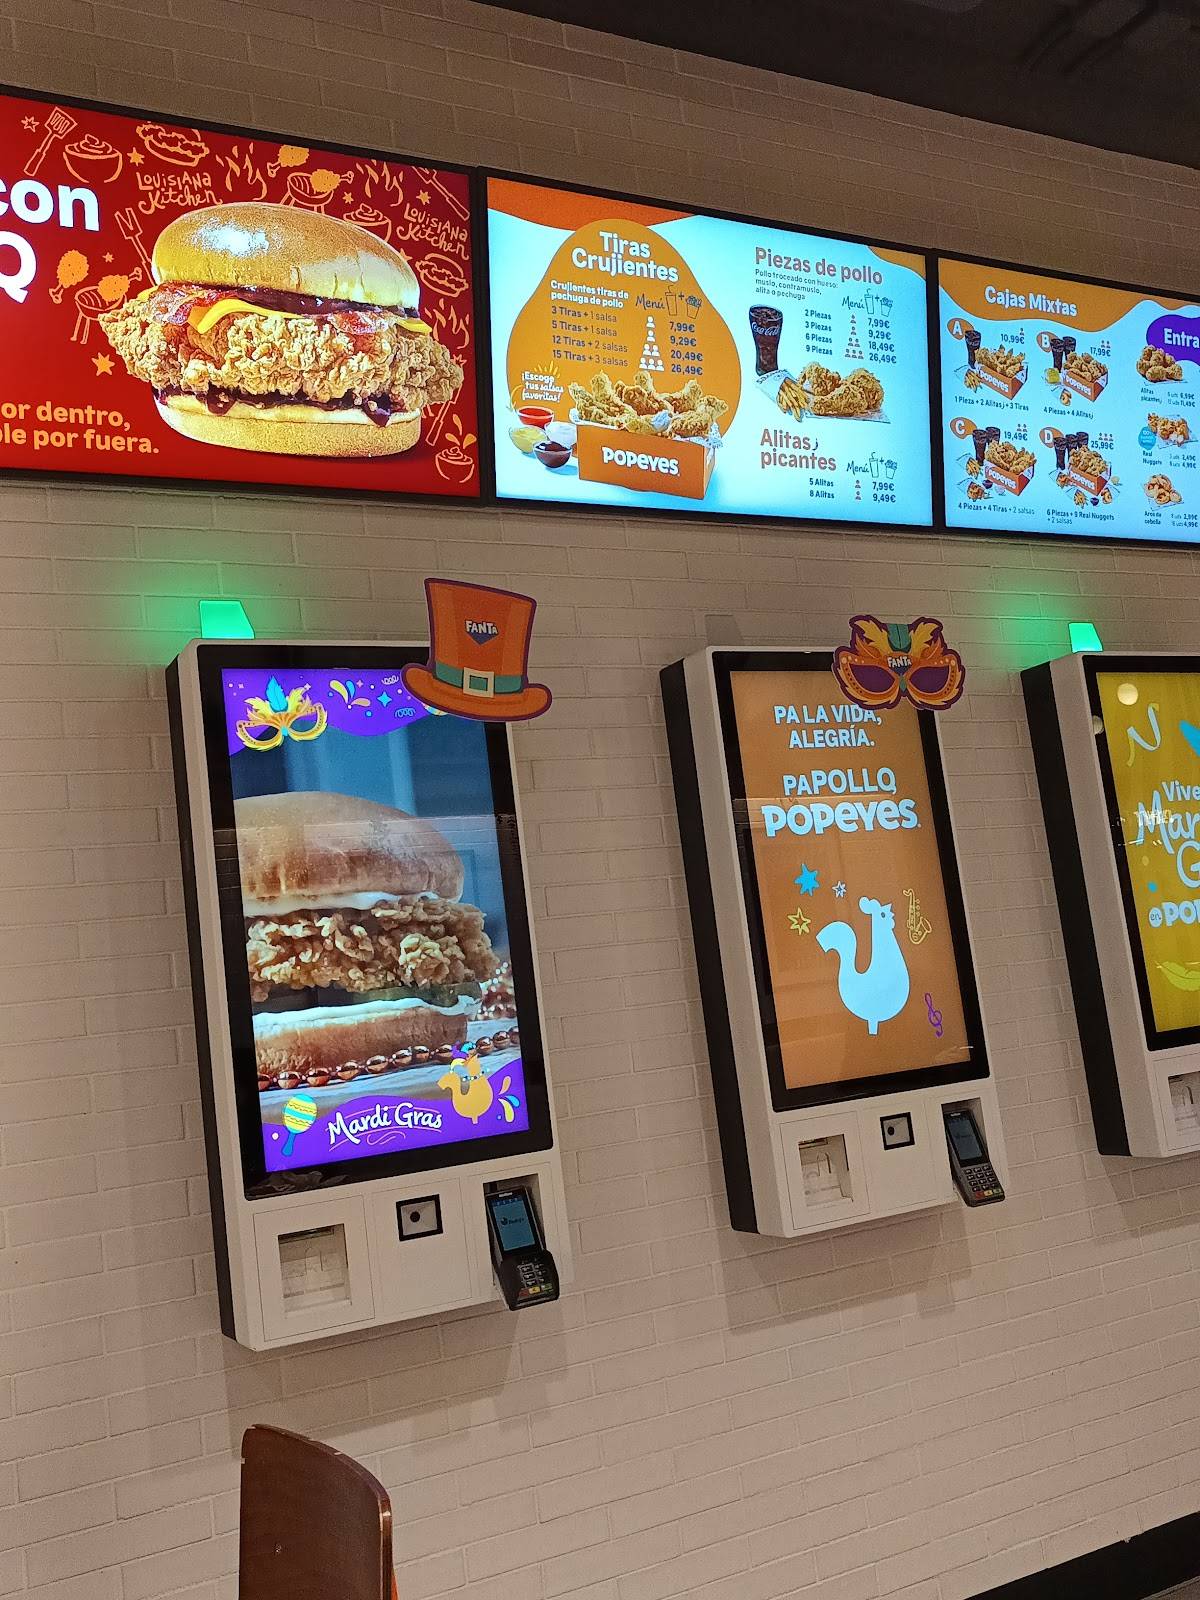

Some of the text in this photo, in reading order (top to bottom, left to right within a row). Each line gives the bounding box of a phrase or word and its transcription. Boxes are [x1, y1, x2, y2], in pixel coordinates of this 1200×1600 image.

[0, 177, 100, 232] on
[138, 185, 223, 214] Kitchen
[396, 222, 469, 260] Kitchen
[599, 231, 651, 258] Tiras
[572, 247, 679, 282] Crujientes
[755, 246, 883, 285] Piezas de pollo
[755, 269, 771, 278] Pollo
[772, 272, 803, 283] troceado
[804, 278, 815, 286] con
[550, 280, 629, 299] Crujientes tiras de
[755, 279, 822, 295] muslo, contramuslo,
[755, 287, 770, 295] alita
[777, 290, 806, 300] pechuga
[551, 291, 624, 308] pechuga de pollo
[985, 285, 1077, 317] Cajas Mixtas
[552, 305, 557, 314] 3
[559, 306, 582, 318] Tiras
[595, 313, 617, 322] salsa
[804, 309, 832, 320] 2 Piezas
[552, 320, 557, 329] 5
[559, 321, 582, 332] Tiras
[595, 327, 617, 336] salsa
[669, 321, 695, 333] 7,99€
[810, 321, 832, 331] Piezas
[867, 318, 890, 328] 7,99€
[952, 320, 963, 336] A
[670, 336, 697, 347] 9,29€
[811, 333, 832, 343] Piezas
[868, 329, 891, 340] 9,29€
[1000, 333, 1025, 344] 10,99€
[1041, 333, 1050, 348] B
[1163, 328, 1200, 348] Entra
[552, 335, 561, 344] 12
[563, 336, 586, 347] Tiras
[595, 340, 600, 349] 2
[602, 342, 628, 353] salsas
[811, 345, 833, 355] Piezas
[868, 341, 895, 352] 18,49€
[553, 349, 562, 359] 15
[564, 350, 586, 362] Tiras
[595, 355, 600, 364] 3
[602, 357, 628, 367] salsas
[670, 349, 703, 362] 20,49€
[868, 352, 897, 364] 26,49€
[1090, 346, 1111, 357] 17,99€
[671, 363, 703, 376] 26,49€
[525, 381, 539, 390] tus
[1014, 402, 1029, 411] Tiras
[36, 401, 131, 431] dentro,
[955, 419, 966, 435] C
[0, 423, 160, 453] le por fuera.
[760, 428, 811, 450] Alitas
[1004, 431, 1028, 441] 19,49€
[1044, 429, 1053, 444] D
[1090, 440, 1114, 450] 25,99€
[760, 447, 837, 471] picantes
[809, 477, 834, 487] 5 Alitas
[872, 481, 895, 491] 7,99€
[809, 489, 835, 499] 8 Alitas
[872, 493, 896, 503] 9,49€
[992, 504, 1007, 512] Tiras
[1091, 511, 1115, 521] Nuggets
[465, 620, 498, 634] FANTA
[887, 656, 912, 668] FANTA
[774, 704, 882, 726] PA LA VIDA,
[789, 724, 875, 748] ALEGRÍA.
[328, 1102, 442, 1145] Mardi Gras
